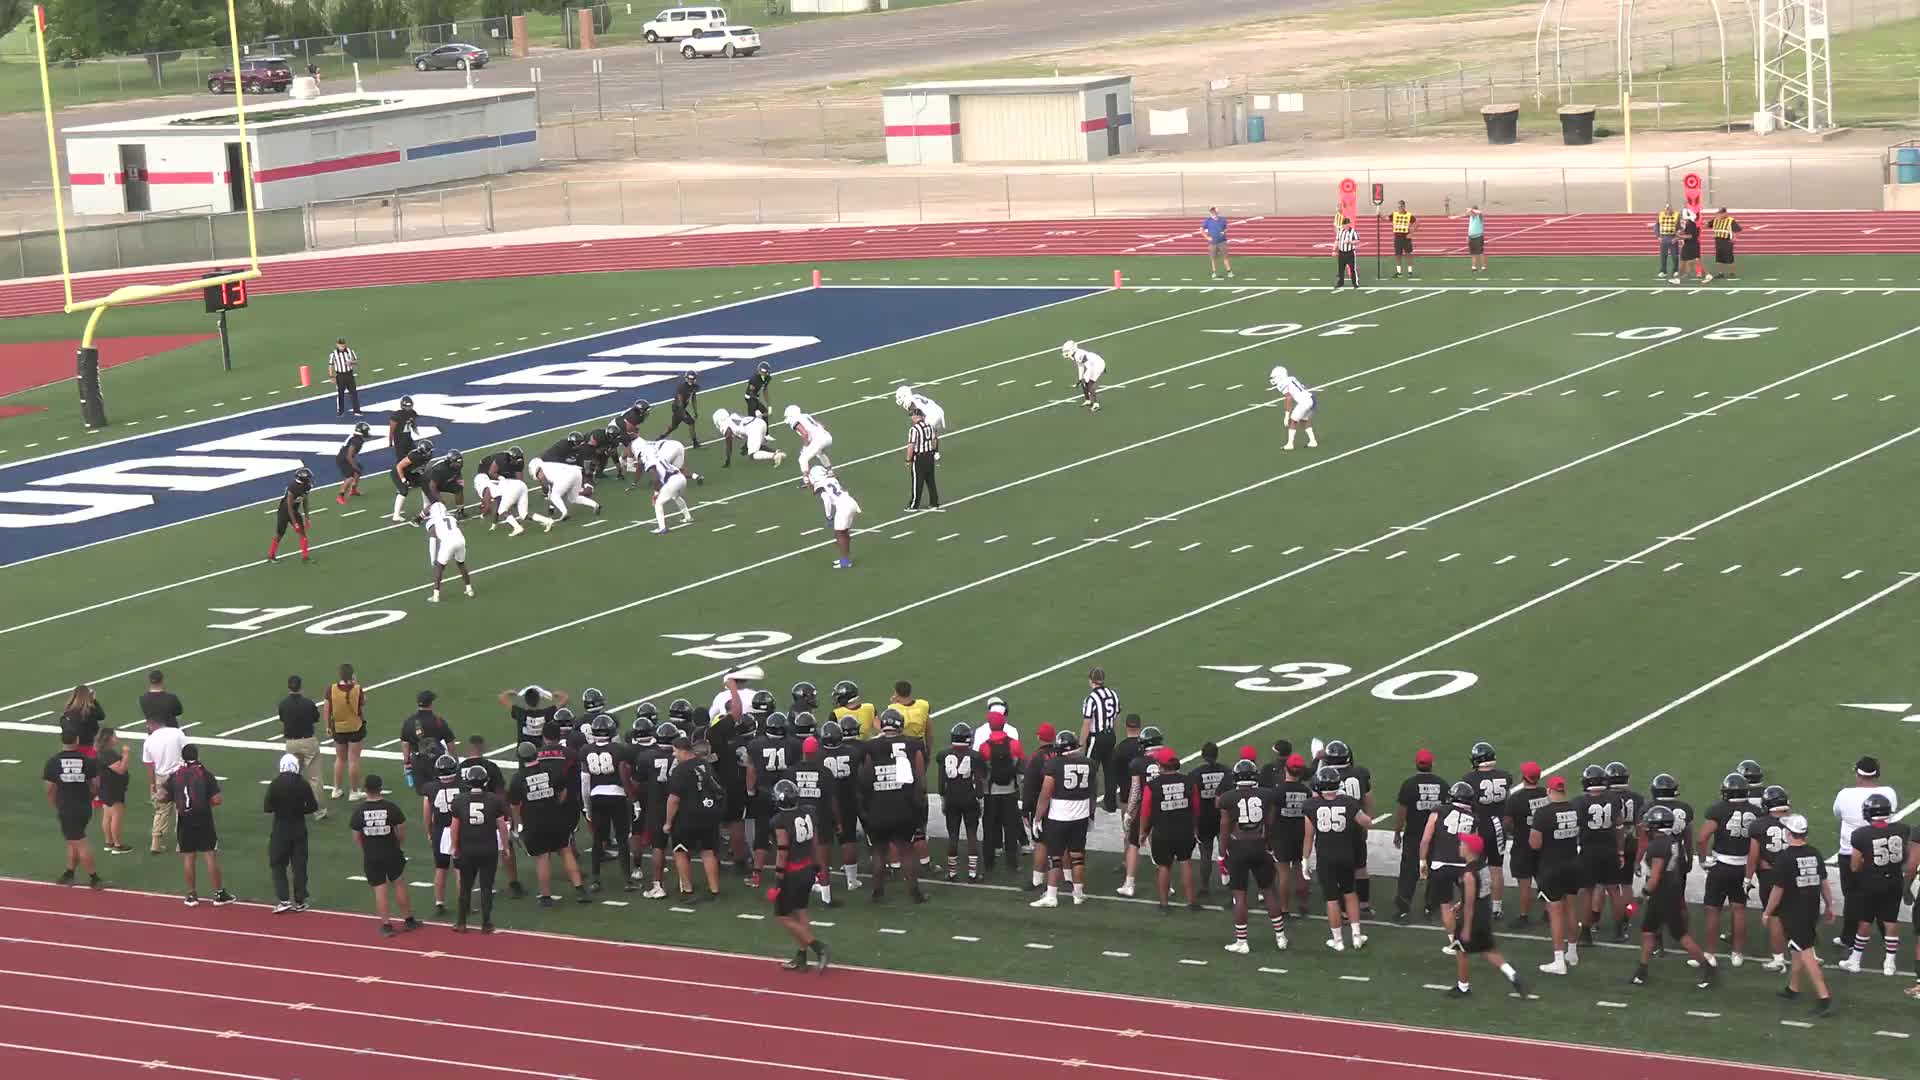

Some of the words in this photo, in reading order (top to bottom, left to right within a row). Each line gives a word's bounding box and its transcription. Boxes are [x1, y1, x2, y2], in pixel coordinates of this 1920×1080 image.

[221, 279, 246, 305] 13
[442, 517, 453, 531] 7
[1105, 699, 1114, 718] S
[586, 752, 614, 776] 88
[763, 747, 788, 771] 71
[824, 755, 850, 778] 95
[944, 754, 971, 779] 84
[1063, 764, 1090, 790] 57
[1480, 778, 1507, 805] 35
[469, 802, 484, 825] 5
[1237, 797, 1263, 823] 16
[1316, 806, 1346, 833] 85
[1587, 803, 1612, 830] 31
[794, 813, 814, 843] 61
[1872, 835, 1903, 867] 59
